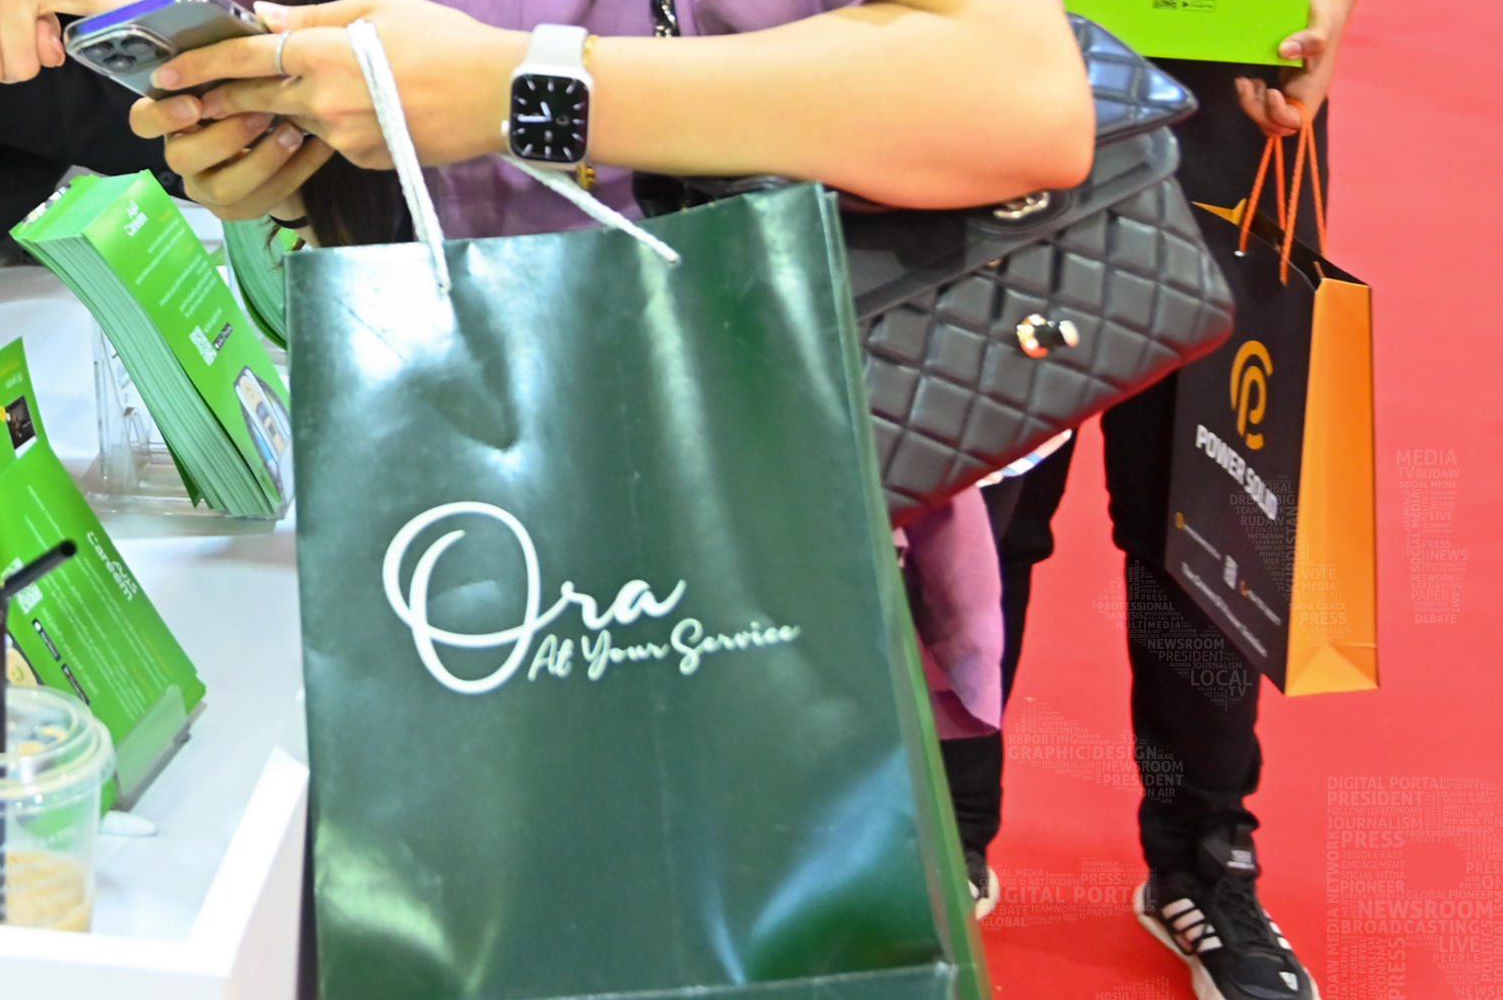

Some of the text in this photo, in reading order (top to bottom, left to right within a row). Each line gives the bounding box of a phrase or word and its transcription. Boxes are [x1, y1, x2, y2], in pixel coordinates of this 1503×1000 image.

[382, 500, 687, 694] Ora
[528, 618, 800, 681] At Your Service
